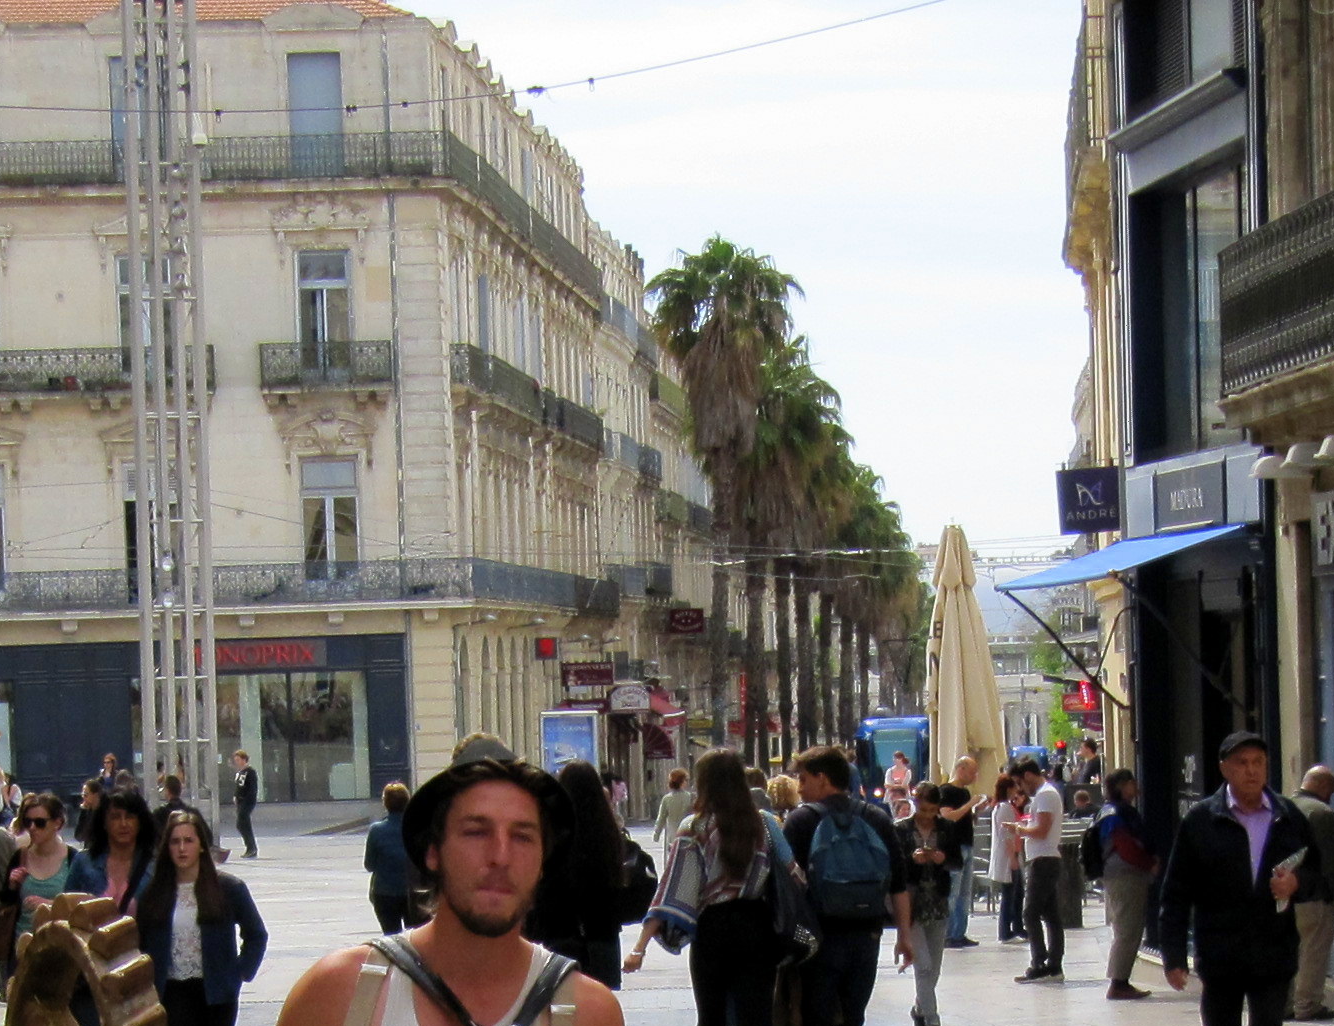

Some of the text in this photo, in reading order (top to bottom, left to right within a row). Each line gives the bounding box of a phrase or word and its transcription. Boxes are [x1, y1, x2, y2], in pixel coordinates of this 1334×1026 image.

[1170, 487, 1204, 512] MADURA
[1066, 506, 1117, 521] ANDRÉ
[194, 643, 315, 668] NOPRIX
